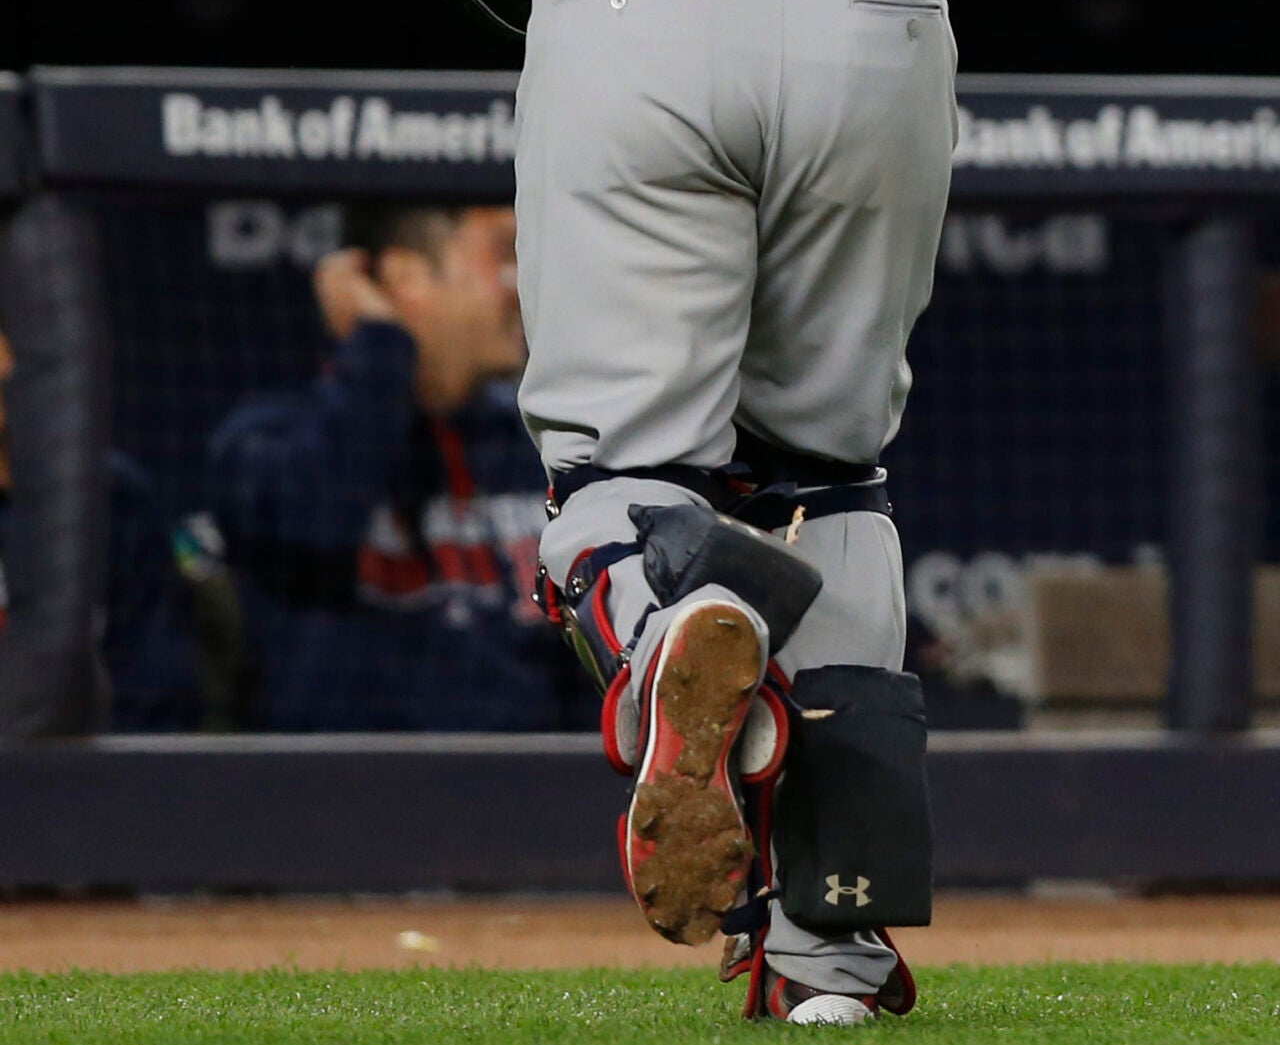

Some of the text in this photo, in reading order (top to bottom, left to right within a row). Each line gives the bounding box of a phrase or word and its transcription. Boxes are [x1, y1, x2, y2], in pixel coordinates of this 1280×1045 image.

[163, 93, 517, 163] Bank of Ameri
[1065, 104, 1125, 170] of
